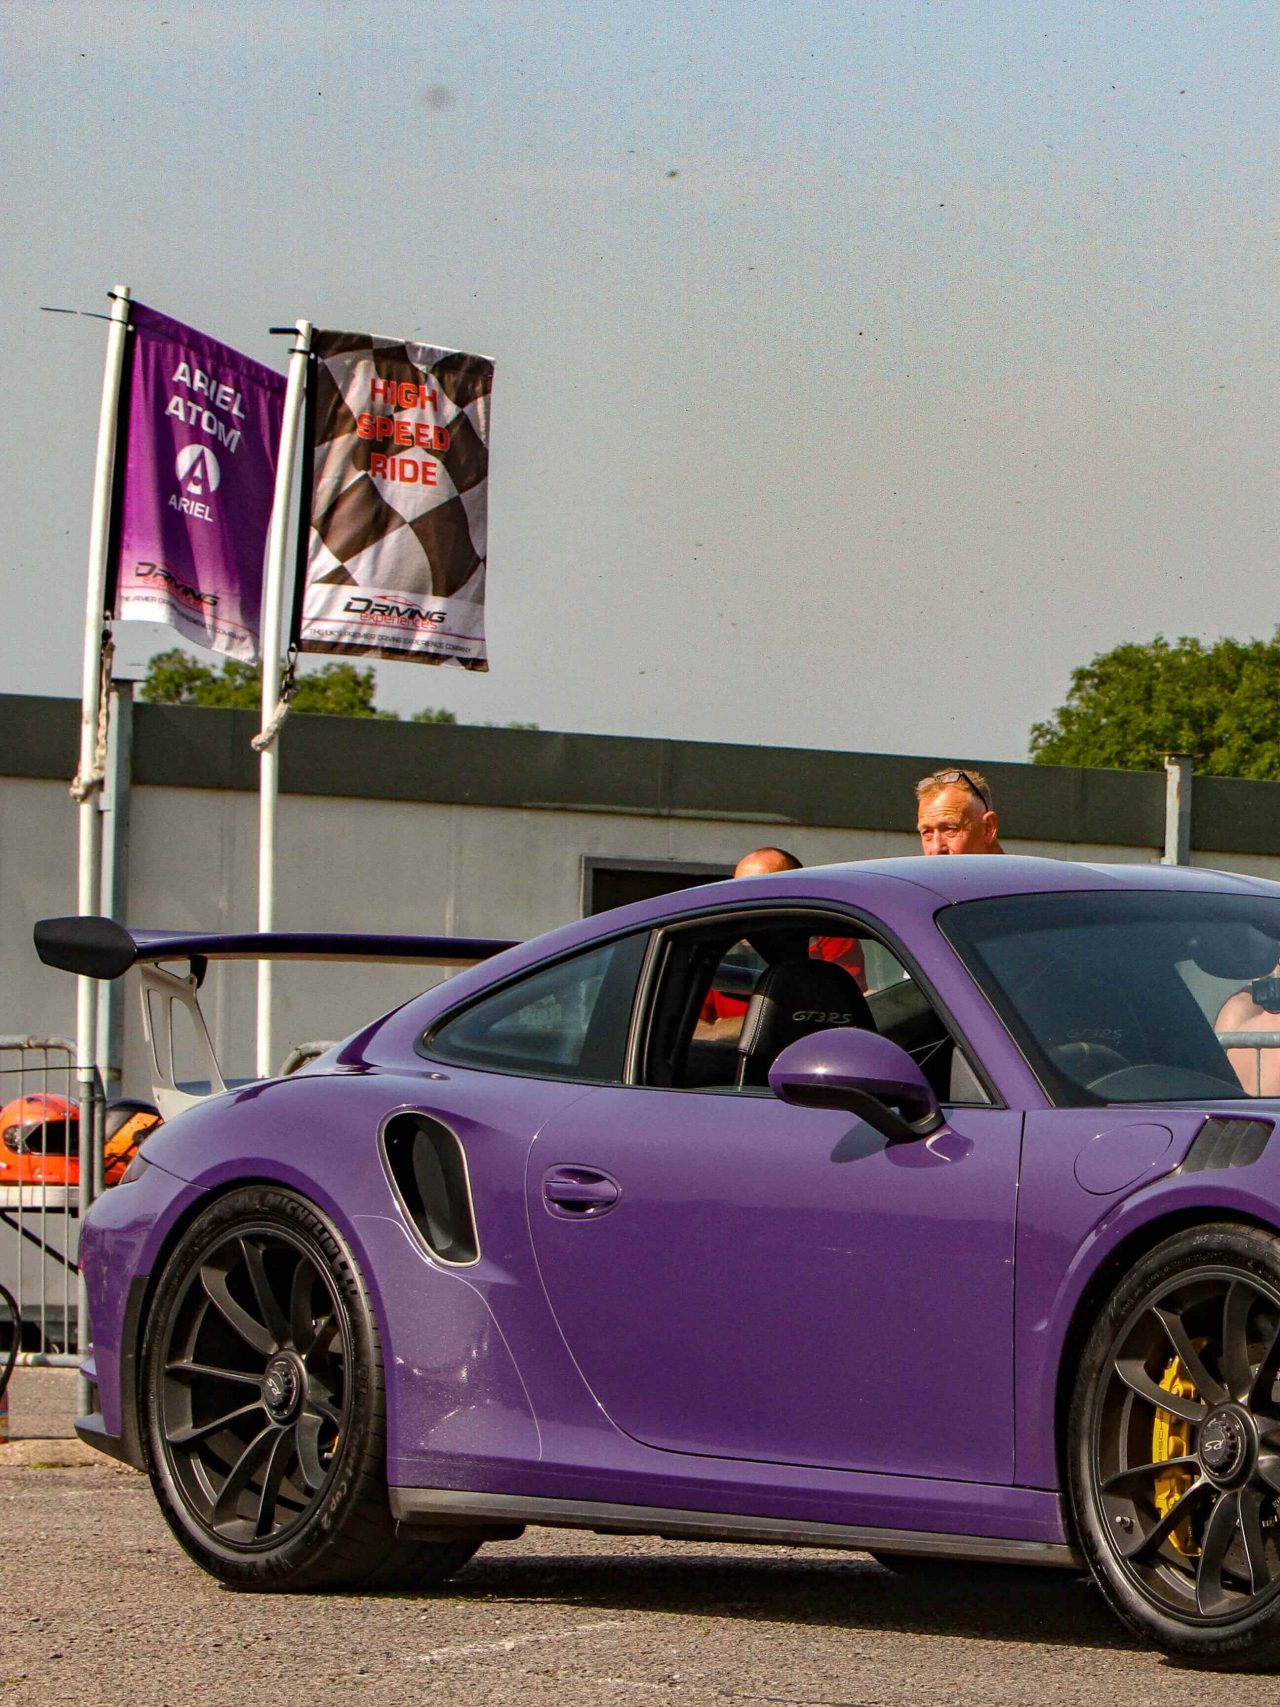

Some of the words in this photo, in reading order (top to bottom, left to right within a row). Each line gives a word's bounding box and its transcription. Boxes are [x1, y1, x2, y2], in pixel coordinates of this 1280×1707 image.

[172, 361, 246, 420] ARIEL
[369, 378, 438, 412] HIGH
[164, 394, 242, 453] ATOM
[355, 412, 450, 451] SPEED
[369, 452, 438, 487] RIDE
[167, 494, 214, 522] ARIEL
[342, 596, 448, 623] DRIVING
[359, 611, 438, 630] experiences
